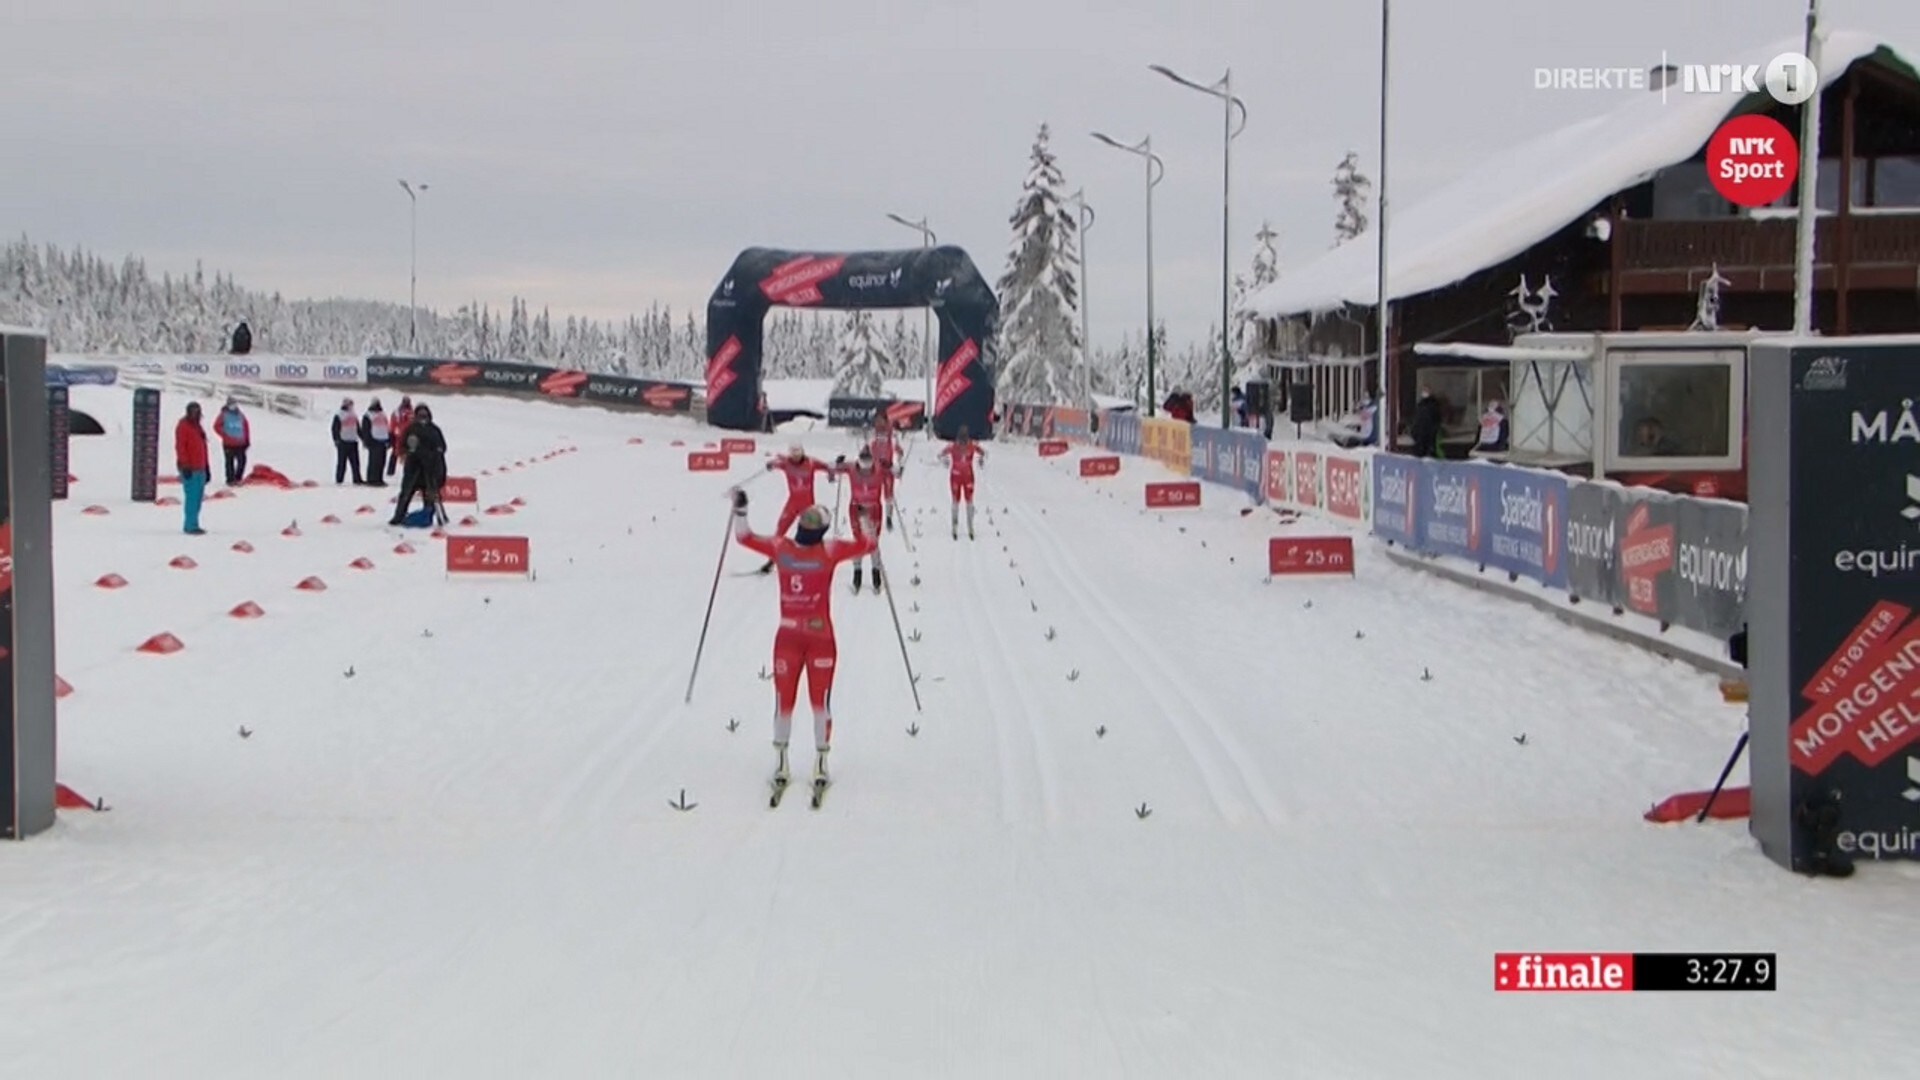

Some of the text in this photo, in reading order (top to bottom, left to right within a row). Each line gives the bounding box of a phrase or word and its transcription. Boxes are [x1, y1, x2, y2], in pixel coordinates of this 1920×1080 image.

[848, 273, 887, 289] equinor
[368, 364, 411, 377] equinor
[484, 370, 526, 384] equinor
[1331, 467, 1360, 505] SPAR
[1501, 480, 1543, 533] SpareBank
[1567, 514, 1602, 567] equinor
[481, 549, 519, 565] 25 m
[1305, 549, 1344, 566] 25 m
[1679, 536, 1734, 597] equinor
[1816, 609, 1895, 696] VI STØTTER
